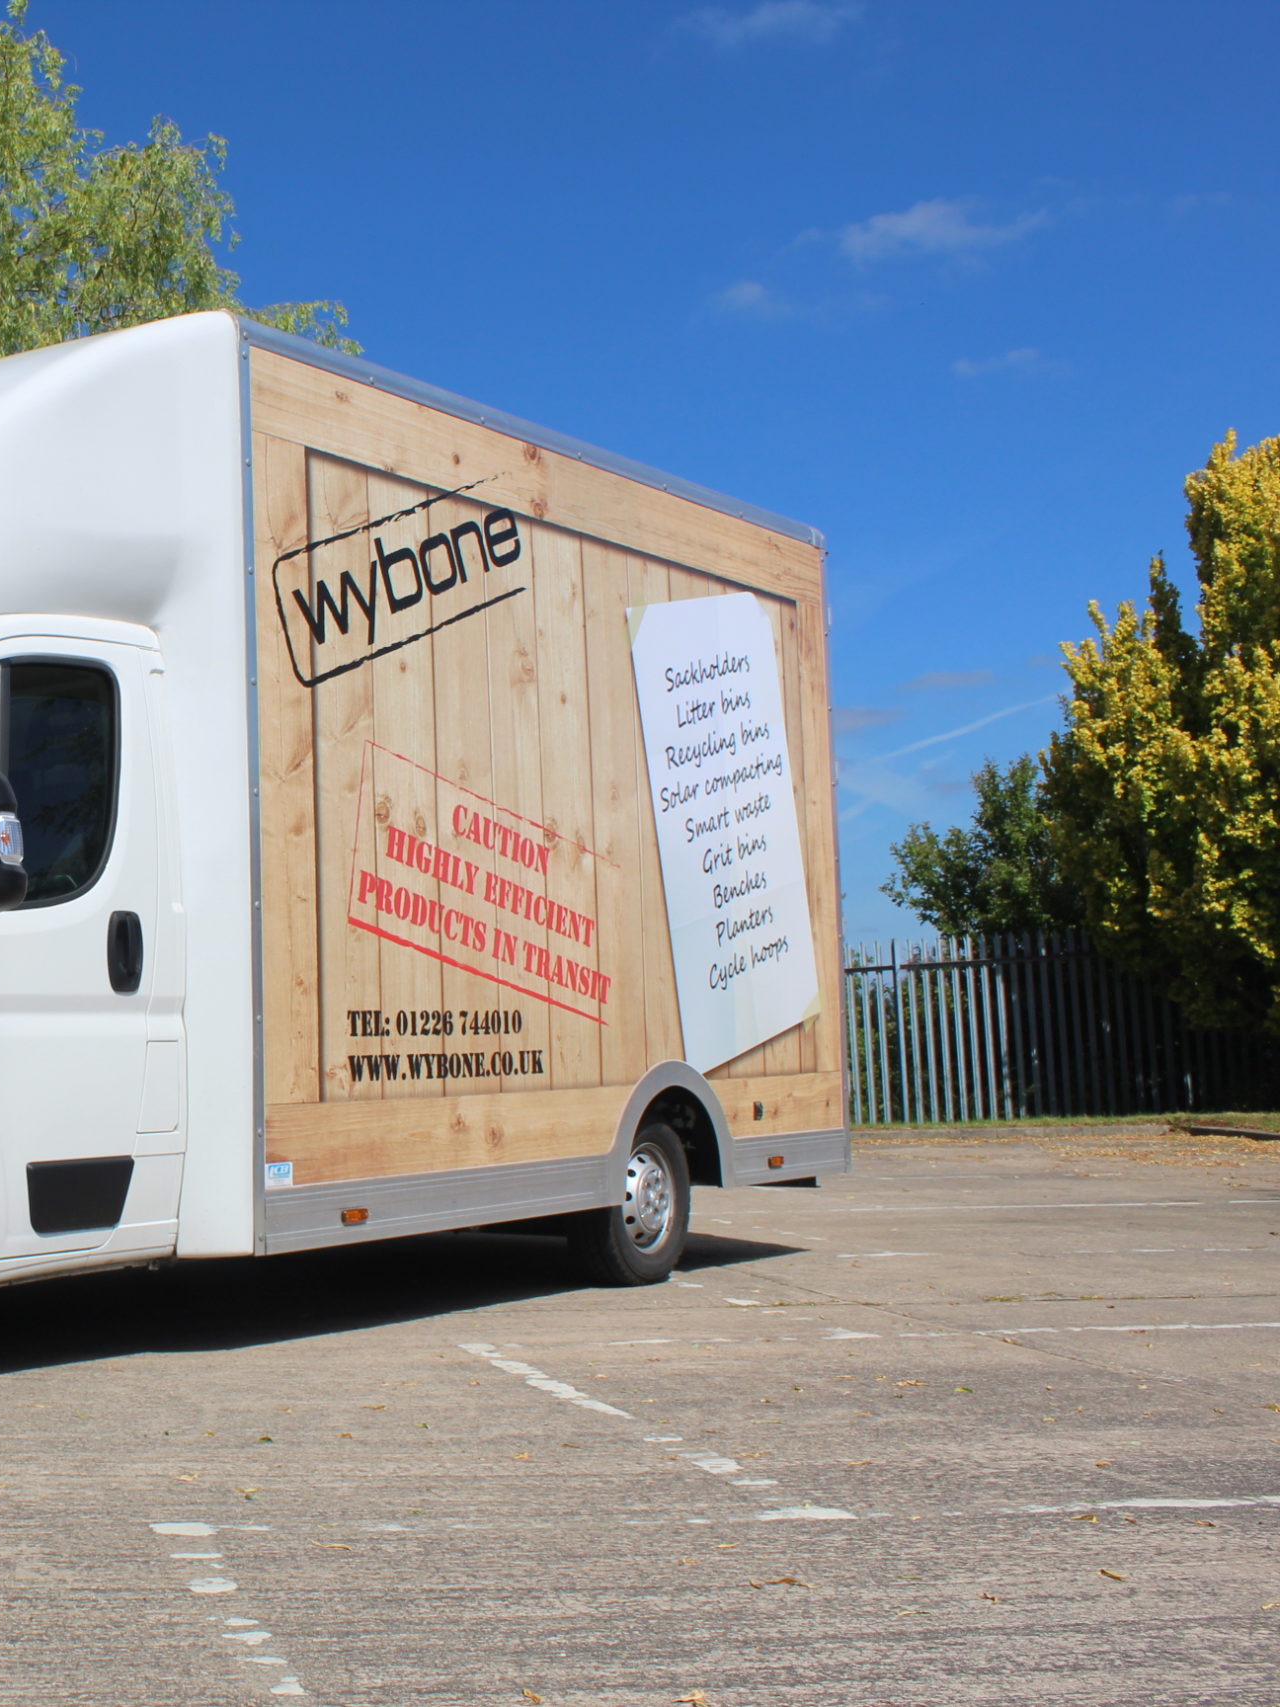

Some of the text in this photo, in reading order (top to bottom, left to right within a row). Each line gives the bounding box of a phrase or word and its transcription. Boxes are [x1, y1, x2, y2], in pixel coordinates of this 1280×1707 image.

[292, 507, 521, 645] wybone
[664, 651, 750, 692] Sackholders
[676, 688, 751, 728] Litter bins
[665, 719, 770, 770] Recycling bins
[660, 753, 782, 813] Solar compacting
[452, 804, 550, 877] CAUTION
[685, 793, 771, 843] Smart waste
[702, 833, 767, 874] Grit bins
[385, 825, 595, 947] HIGHLY EFFICIENT
[712, 870, 767, 909] Benches
[357, 869, 611, 1005] PRODUCTS IN TRANSIT
[715, 905, 773, 947] Planters
[709, 934, 789, 991] Cycle hoops
[347, 1009, 522, 1037] TEL: 01226 744010
[348, 1050, 544, 1082] WWW.WYBONE.CO.UK
